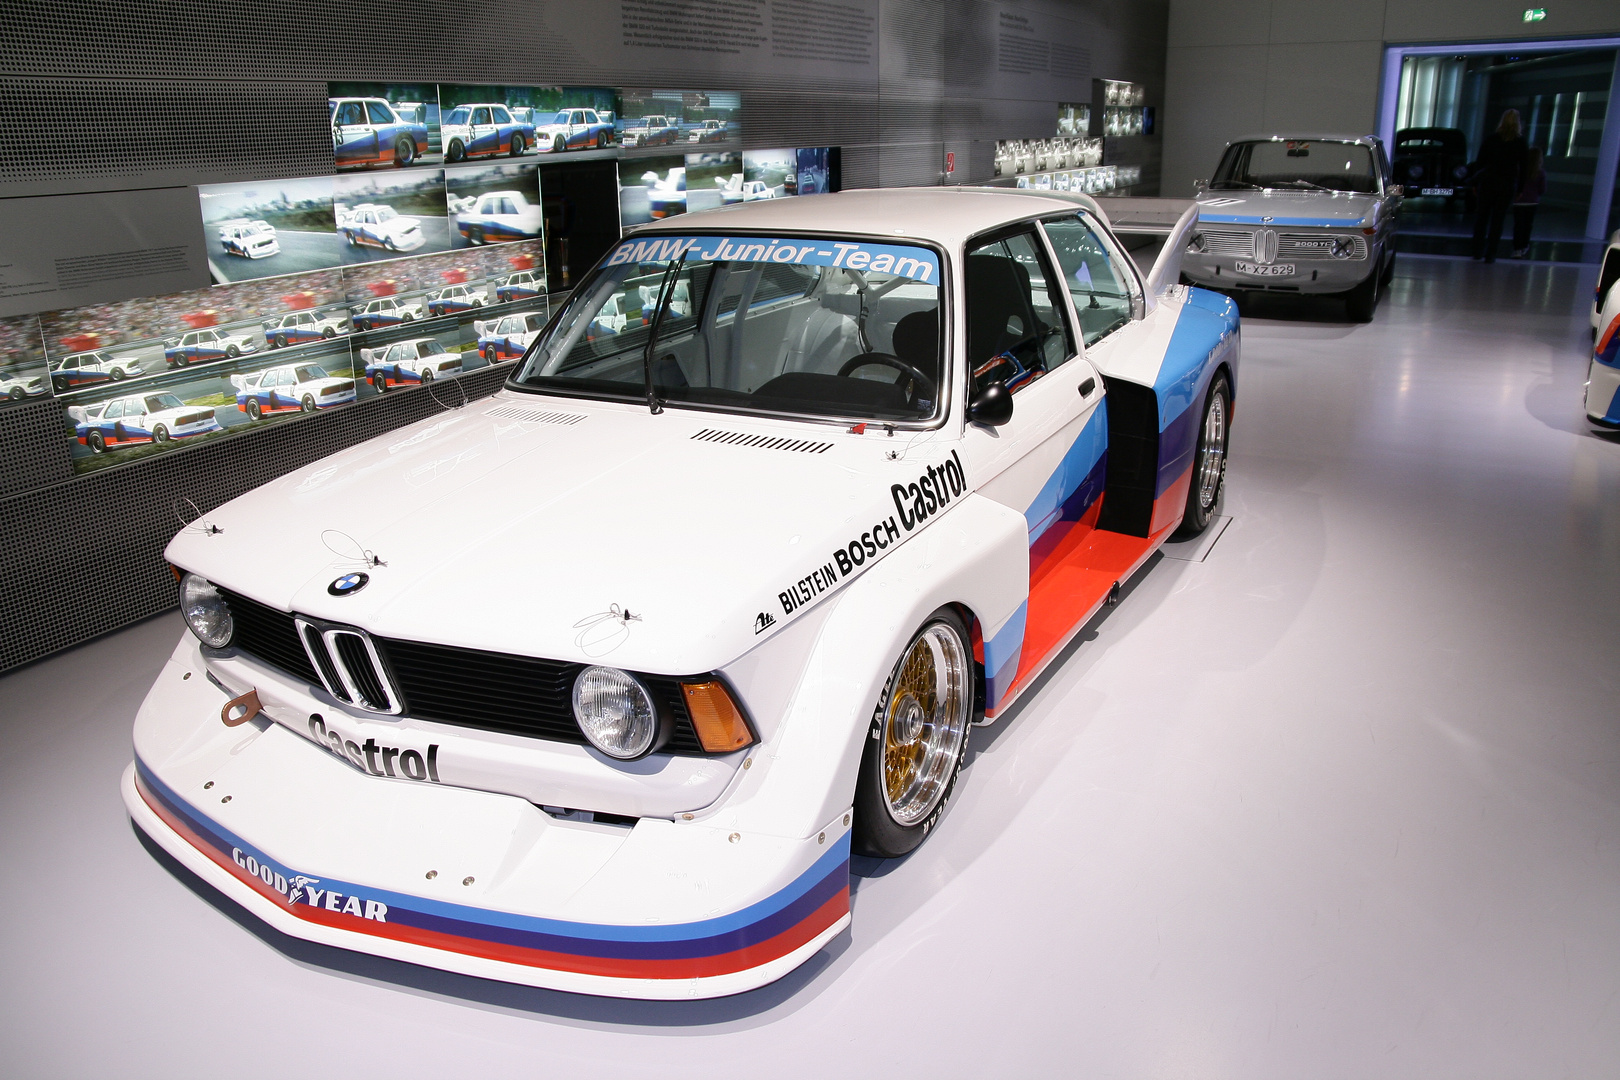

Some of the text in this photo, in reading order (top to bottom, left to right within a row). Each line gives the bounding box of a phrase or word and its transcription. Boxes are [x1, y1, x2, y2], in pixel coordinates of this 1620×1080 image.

[1271, 265, 1294, 275] 629
[891, 449, 967, 531] Castrol
[833, 515, 901, 577] BOSCH
[778, 562, 838, 615] BILSTEIN
[308, 712, 441, 783] Castrol
